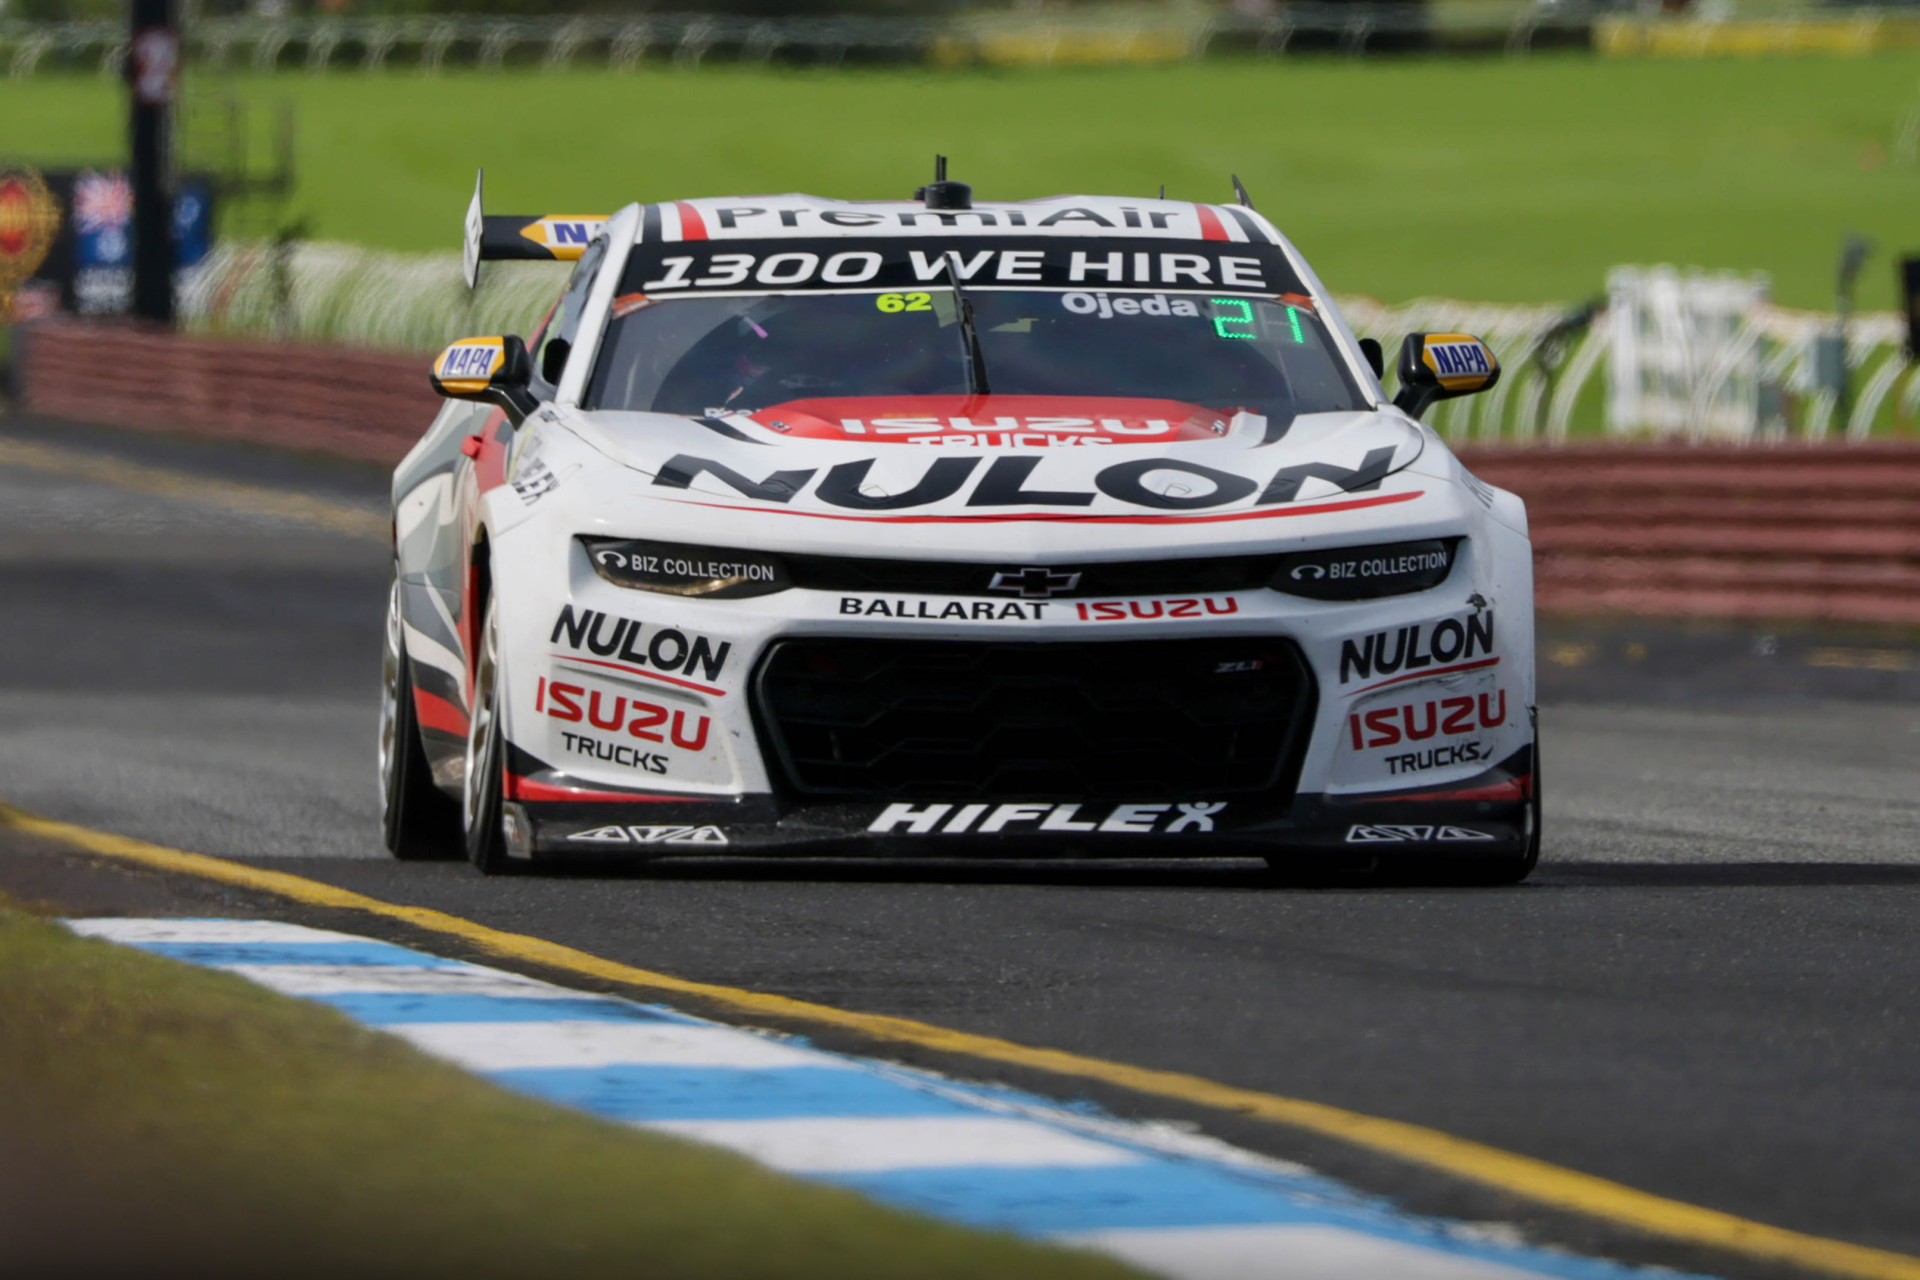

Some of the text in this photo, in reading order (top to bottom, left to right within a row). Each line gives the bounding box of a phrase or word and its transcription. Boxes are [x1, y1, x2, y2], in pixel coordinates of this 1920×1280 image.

[716, 206, 1180, 229] PremiAir
[643, 249, 1267, 290] 1300 WE HIRE
[876, 292, 932, 313] 62
[1061, 292, 1200, 319] Ojeda
[1211, 298, 1304, 343] 21
[441, 348, 495, 375] NAPA
[1432, 344, 1490, 374] NAPA
[840, 417, 1171, 435] ISUZU
[651, 445, 1398, 511] NULON
[631, 554, 774, 581] BIZ COLLECTION
[1329, 551, 1447, 579] BIZ COLLECTION
[839, 597, 1239, 621] BALLARAT ISUZU
[550, 603, 732, 682] NULON
[1340, 610, 1494, 684] NULON
[535, 675, 711, 752] ISUZU
[1349, 688, 1506, 751] ISUZU
[561, 731, 669, 775] TRUCKS
[1385, 741, 1482, 775] TRUCKS
[867, 801, 1227, 833] HIFLEX
